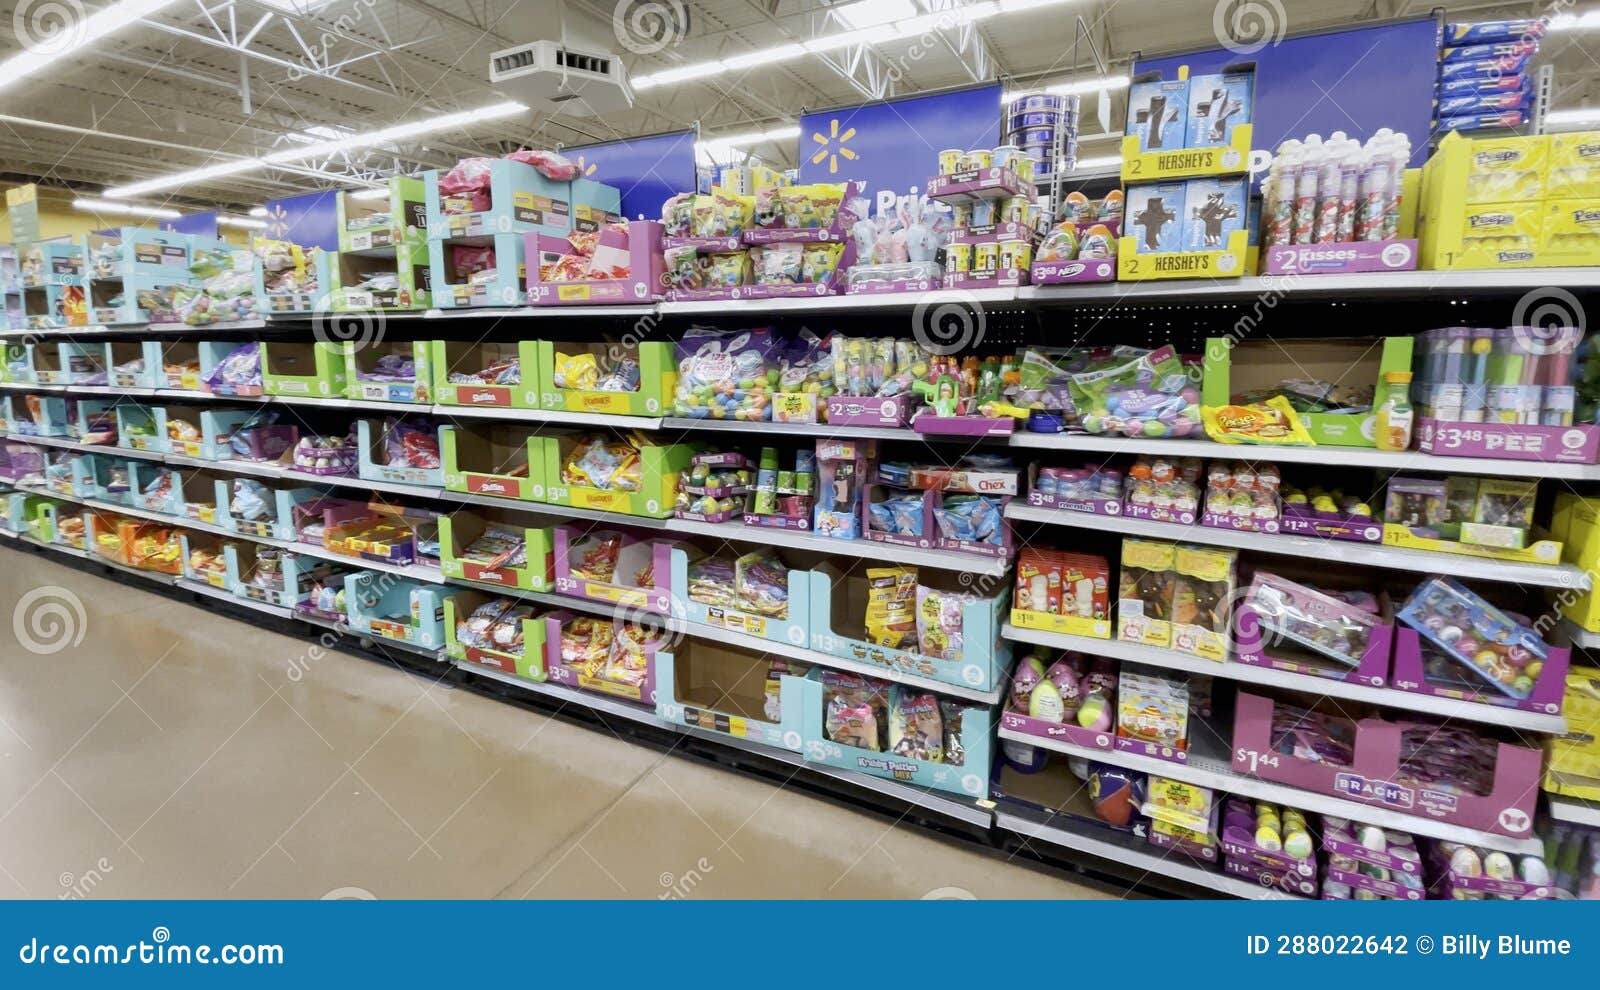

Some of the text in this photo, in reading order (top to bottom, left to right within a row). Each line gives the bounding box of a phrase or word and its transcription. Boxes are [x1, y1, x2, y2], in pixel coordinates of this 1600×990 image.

[1128, 159, 1142, 174] $2
[1158, 152, 1213, 170] HERSHEY'S
[1468, 214, 1514, 228] Peeps
[1155, 255, 1209, 271] HERSHEY'S
[1275, 250, 1297, 270] $2
[1496, 249, 1534, 263] Peeps
[1124, 259, 1139, 274] $2
[831, 403, 843, 416] $2
[1437, 429, 1482, 449] $348
[1485, 432, 1543, 453] PEZ
[979, 479, 1005, 491] Chex
[1030, 492, 1054, 506] $348
[1059, 501, 1094, 512] mentos
[1236, 748, 1280, 772] $144
[1339, 778, 1410, 802] BRACH'S
